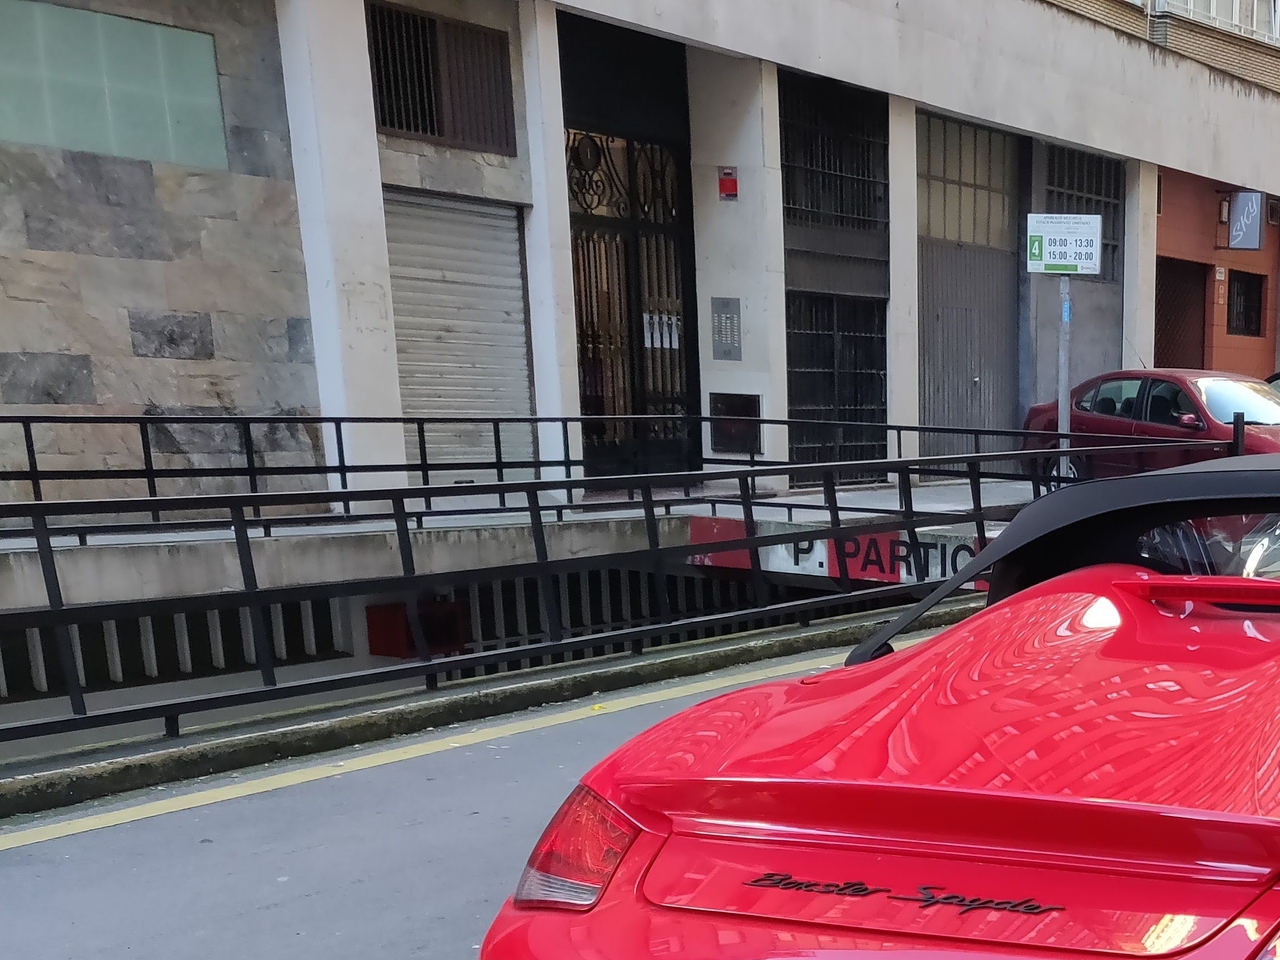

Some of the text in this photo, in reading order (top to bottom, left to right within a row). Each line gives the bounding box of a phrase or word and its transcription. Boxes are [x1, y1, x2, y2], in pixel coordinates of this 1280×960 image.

[1031, 241, 1040, 256] 4
[1048, 238, 1068, 248] 09:00
[1074, 238, 1094, 248] 13:30
[1048, 251, 1068, 260] 15:00
[1074, 251, 1094, 261] 20:00
[743, 872, 1066, 916] Boxster Spyder
